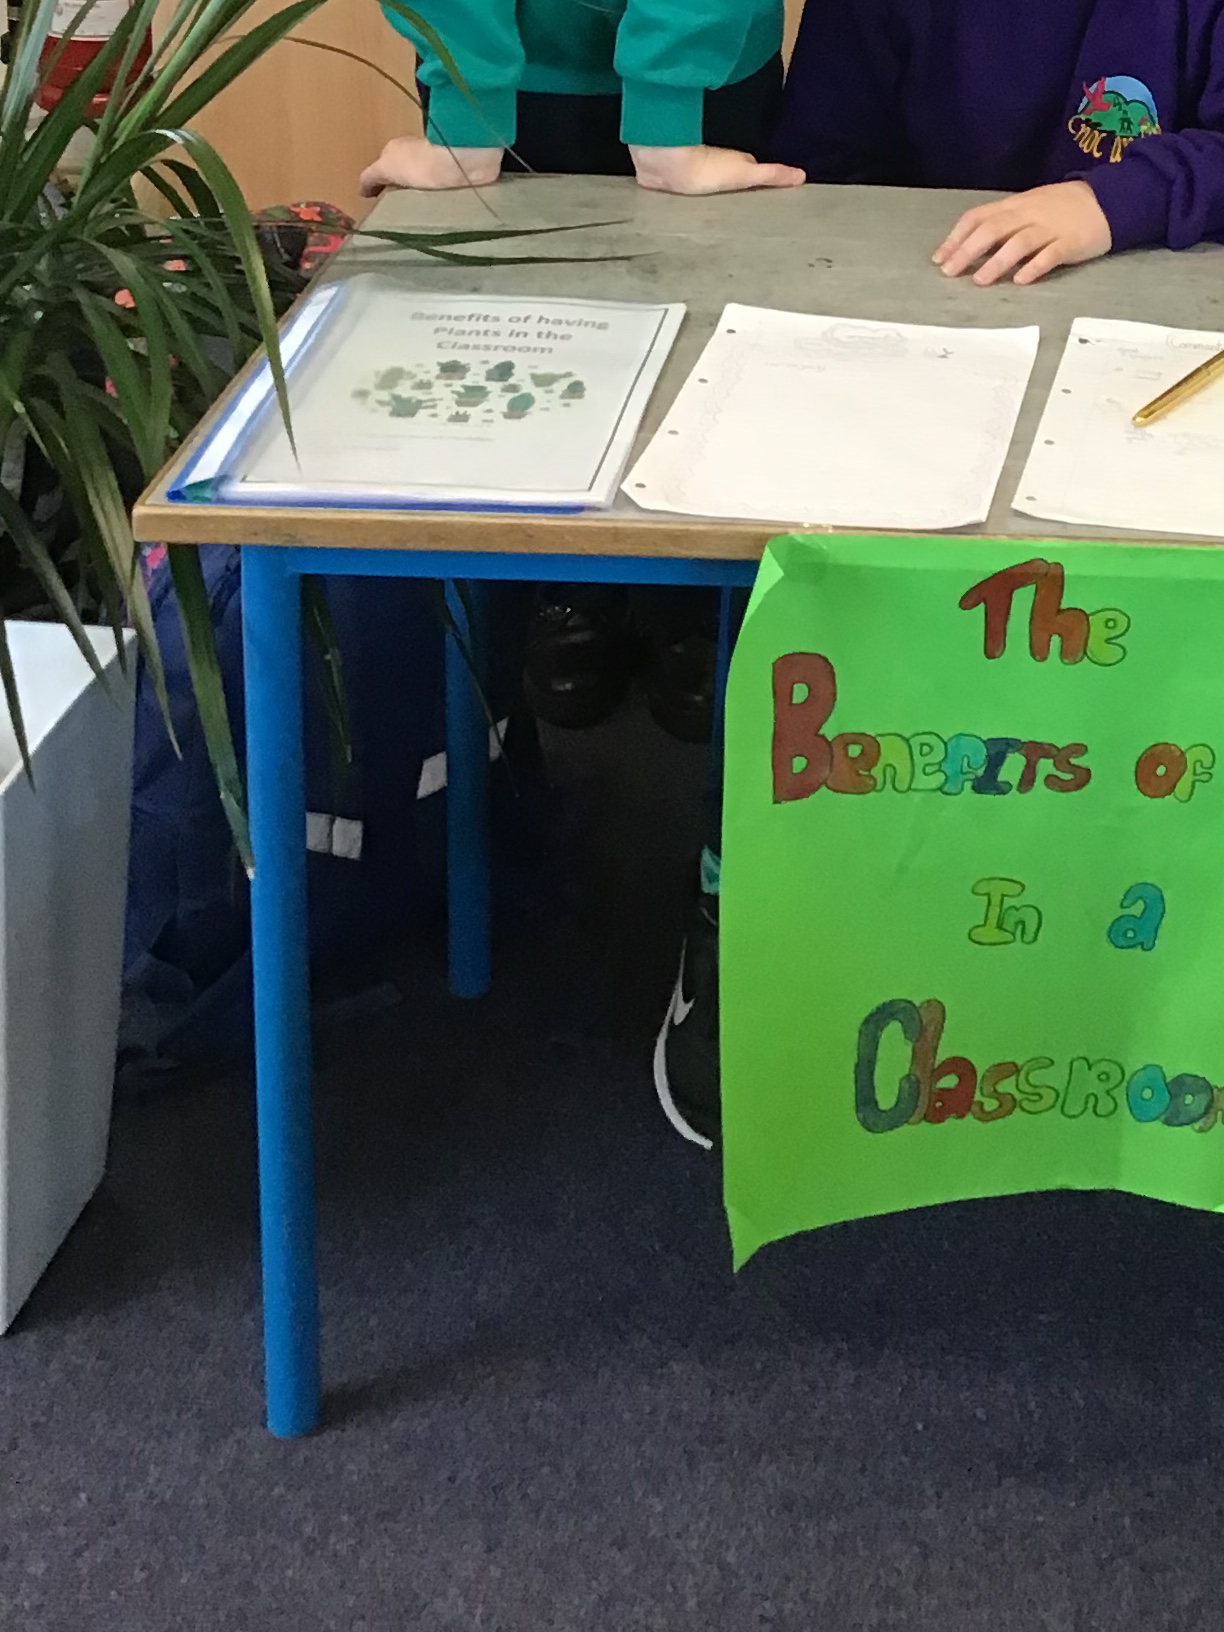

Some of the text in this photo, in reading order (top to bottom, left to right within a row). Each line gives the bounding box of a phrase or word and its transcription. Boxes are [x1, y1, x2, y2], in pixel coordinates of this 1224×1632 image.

[508, 313, 533, 325] of
[536, 314, 610, 331] having
[433, 325, 573, 342] Plants in the
[436, 340, 554, 355] Classroom
[958, 557, 1131, 667] The
[967, 876, 1167, 952] In a
